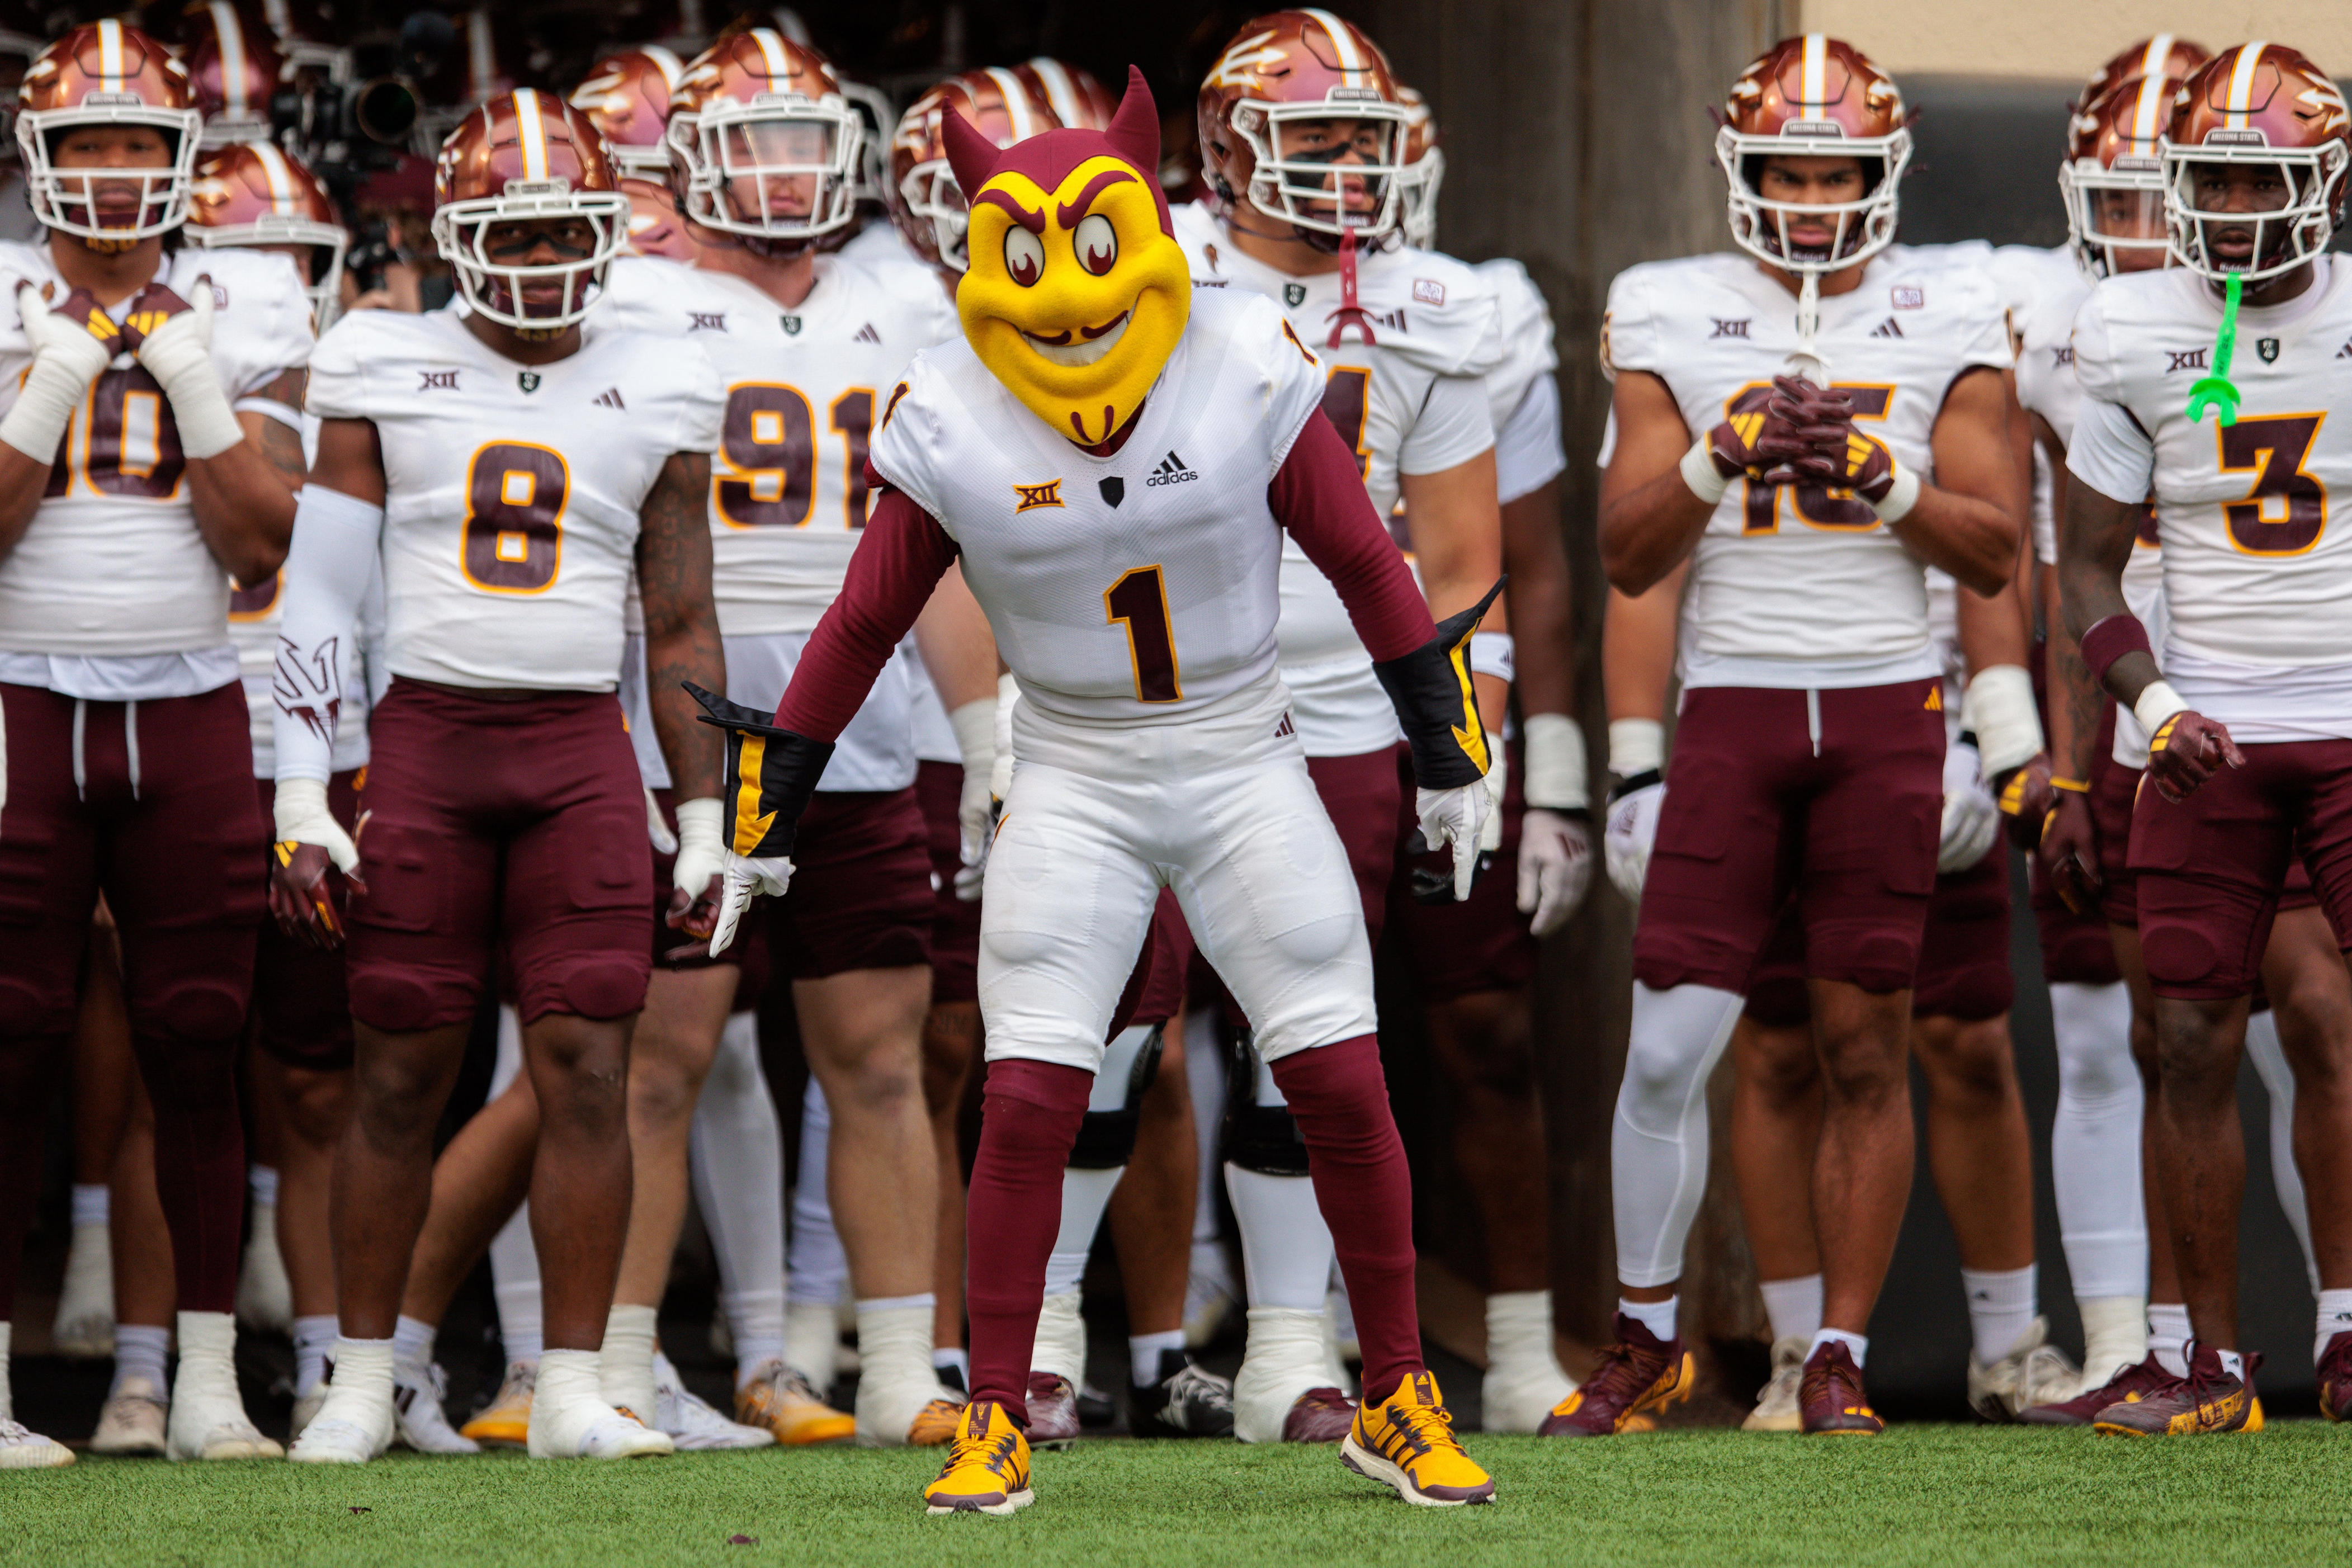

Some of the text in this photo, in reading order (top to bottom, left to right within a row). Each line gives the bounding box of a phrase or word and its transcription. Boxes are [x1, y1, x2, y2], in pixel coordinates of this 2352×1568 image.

[2211, 132, 2259, 142] ARIZONA STATE
[2145, 159, 2161, 169] STAT
[686, 311, 728, 334] XII
[1709, 317, 1752, 340] XII
[2164, 347, 2209, 375] XII
[417, 369, 460, 393] XII
[712, 380, 877, 531] 91
[1146, 470, 1198, 487] adidas
[2214, 411, 2327, 557] 3
[1014, 479, 1063, 511] XII
[460, 439, 570, 595] 8
[1102, 563, 1184, 704] 1
